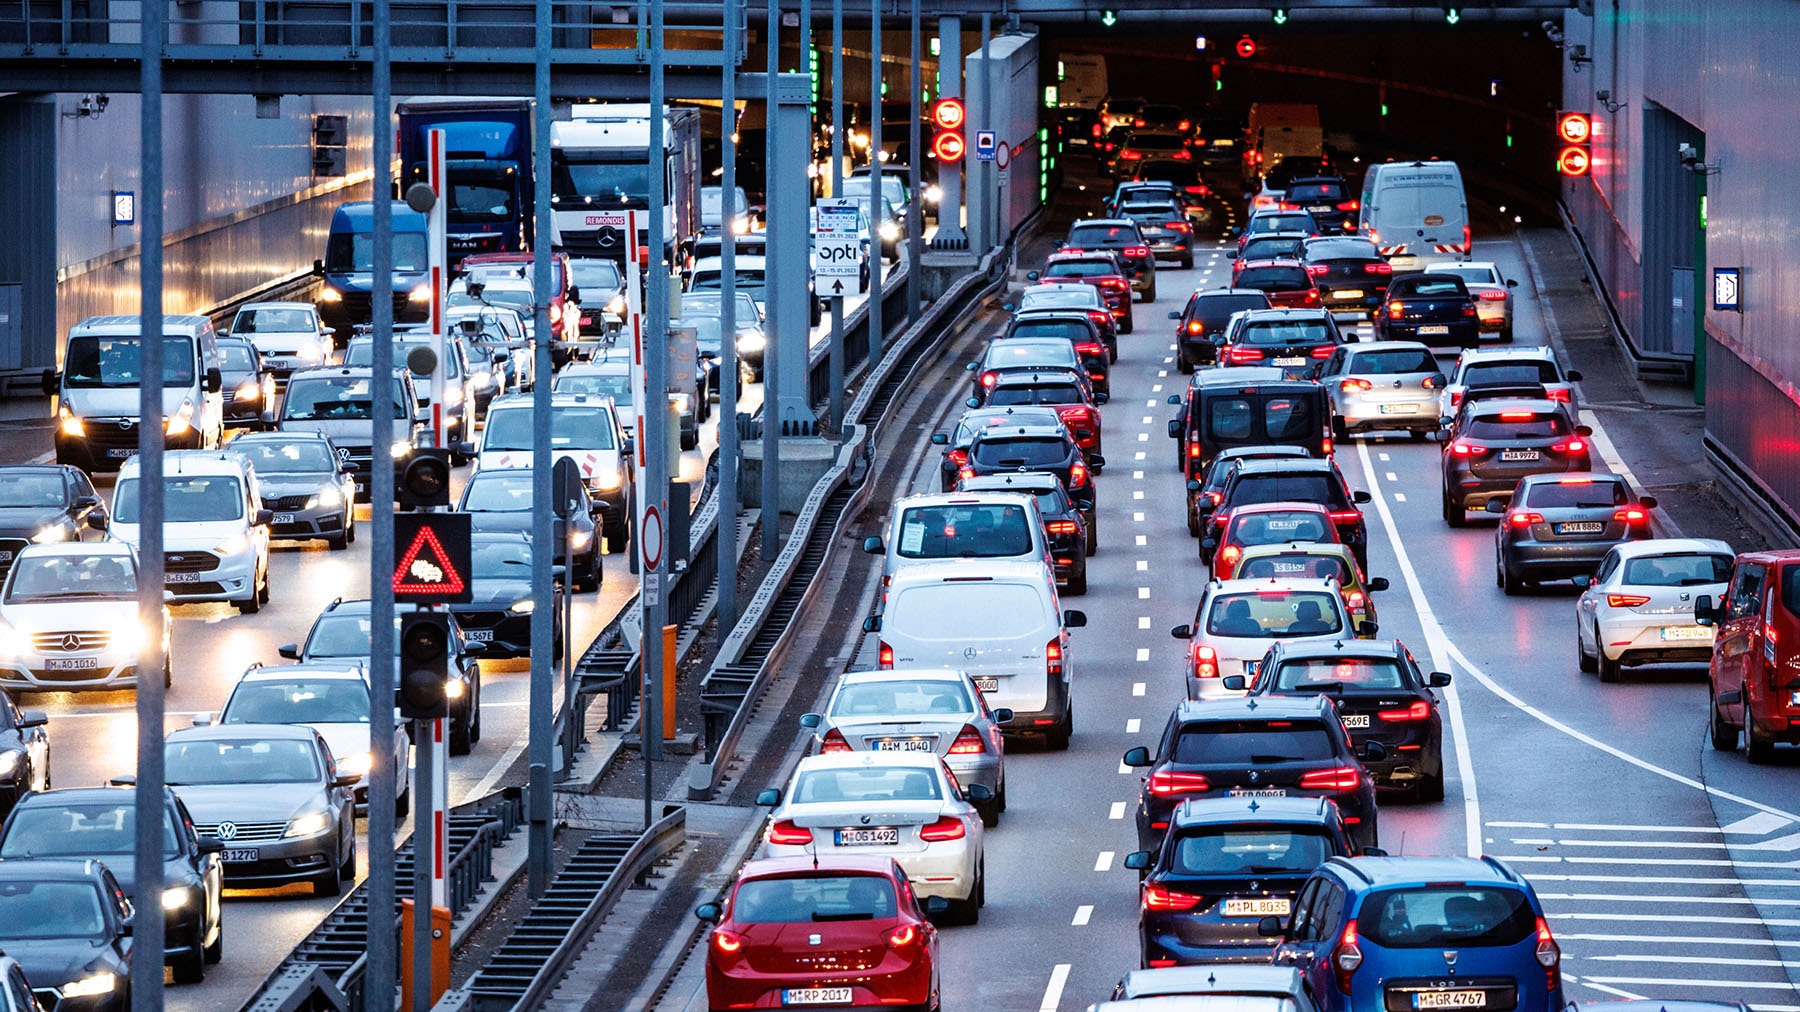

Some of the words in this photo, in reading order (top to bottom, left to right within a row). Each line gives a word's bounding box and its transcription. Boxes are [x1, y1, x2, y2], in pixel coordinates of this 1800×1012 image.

[586, 217, 624, 225] REMONDIS
[819, 244, 856, 263] opti
[185, 573, 199, 582] 250
[894, 742, 900, 750] M
[905, 742, 928, 751] 1040
[842, 832, 848, 841] M
[855, 831, 868, 841] OG
[871, 831, 896, 841] 1492
[222, 851, 229, 860] B
[231, 850, 257, 860] 1270
[1228, 902, 1235, 912] M
[1243, 902, 1257, 912] PL
[1260, 901, 1287, 912] 8035
[789, 991, 796, 1001] M
[804, 990, 818, 1001] RP
[822, 989, 849, 1000] 2017
[1420, 994, 1428, 1005] M
[1435, 993, 1451, 1005] GR
[1453, 993, 1482, 1004] 4767
